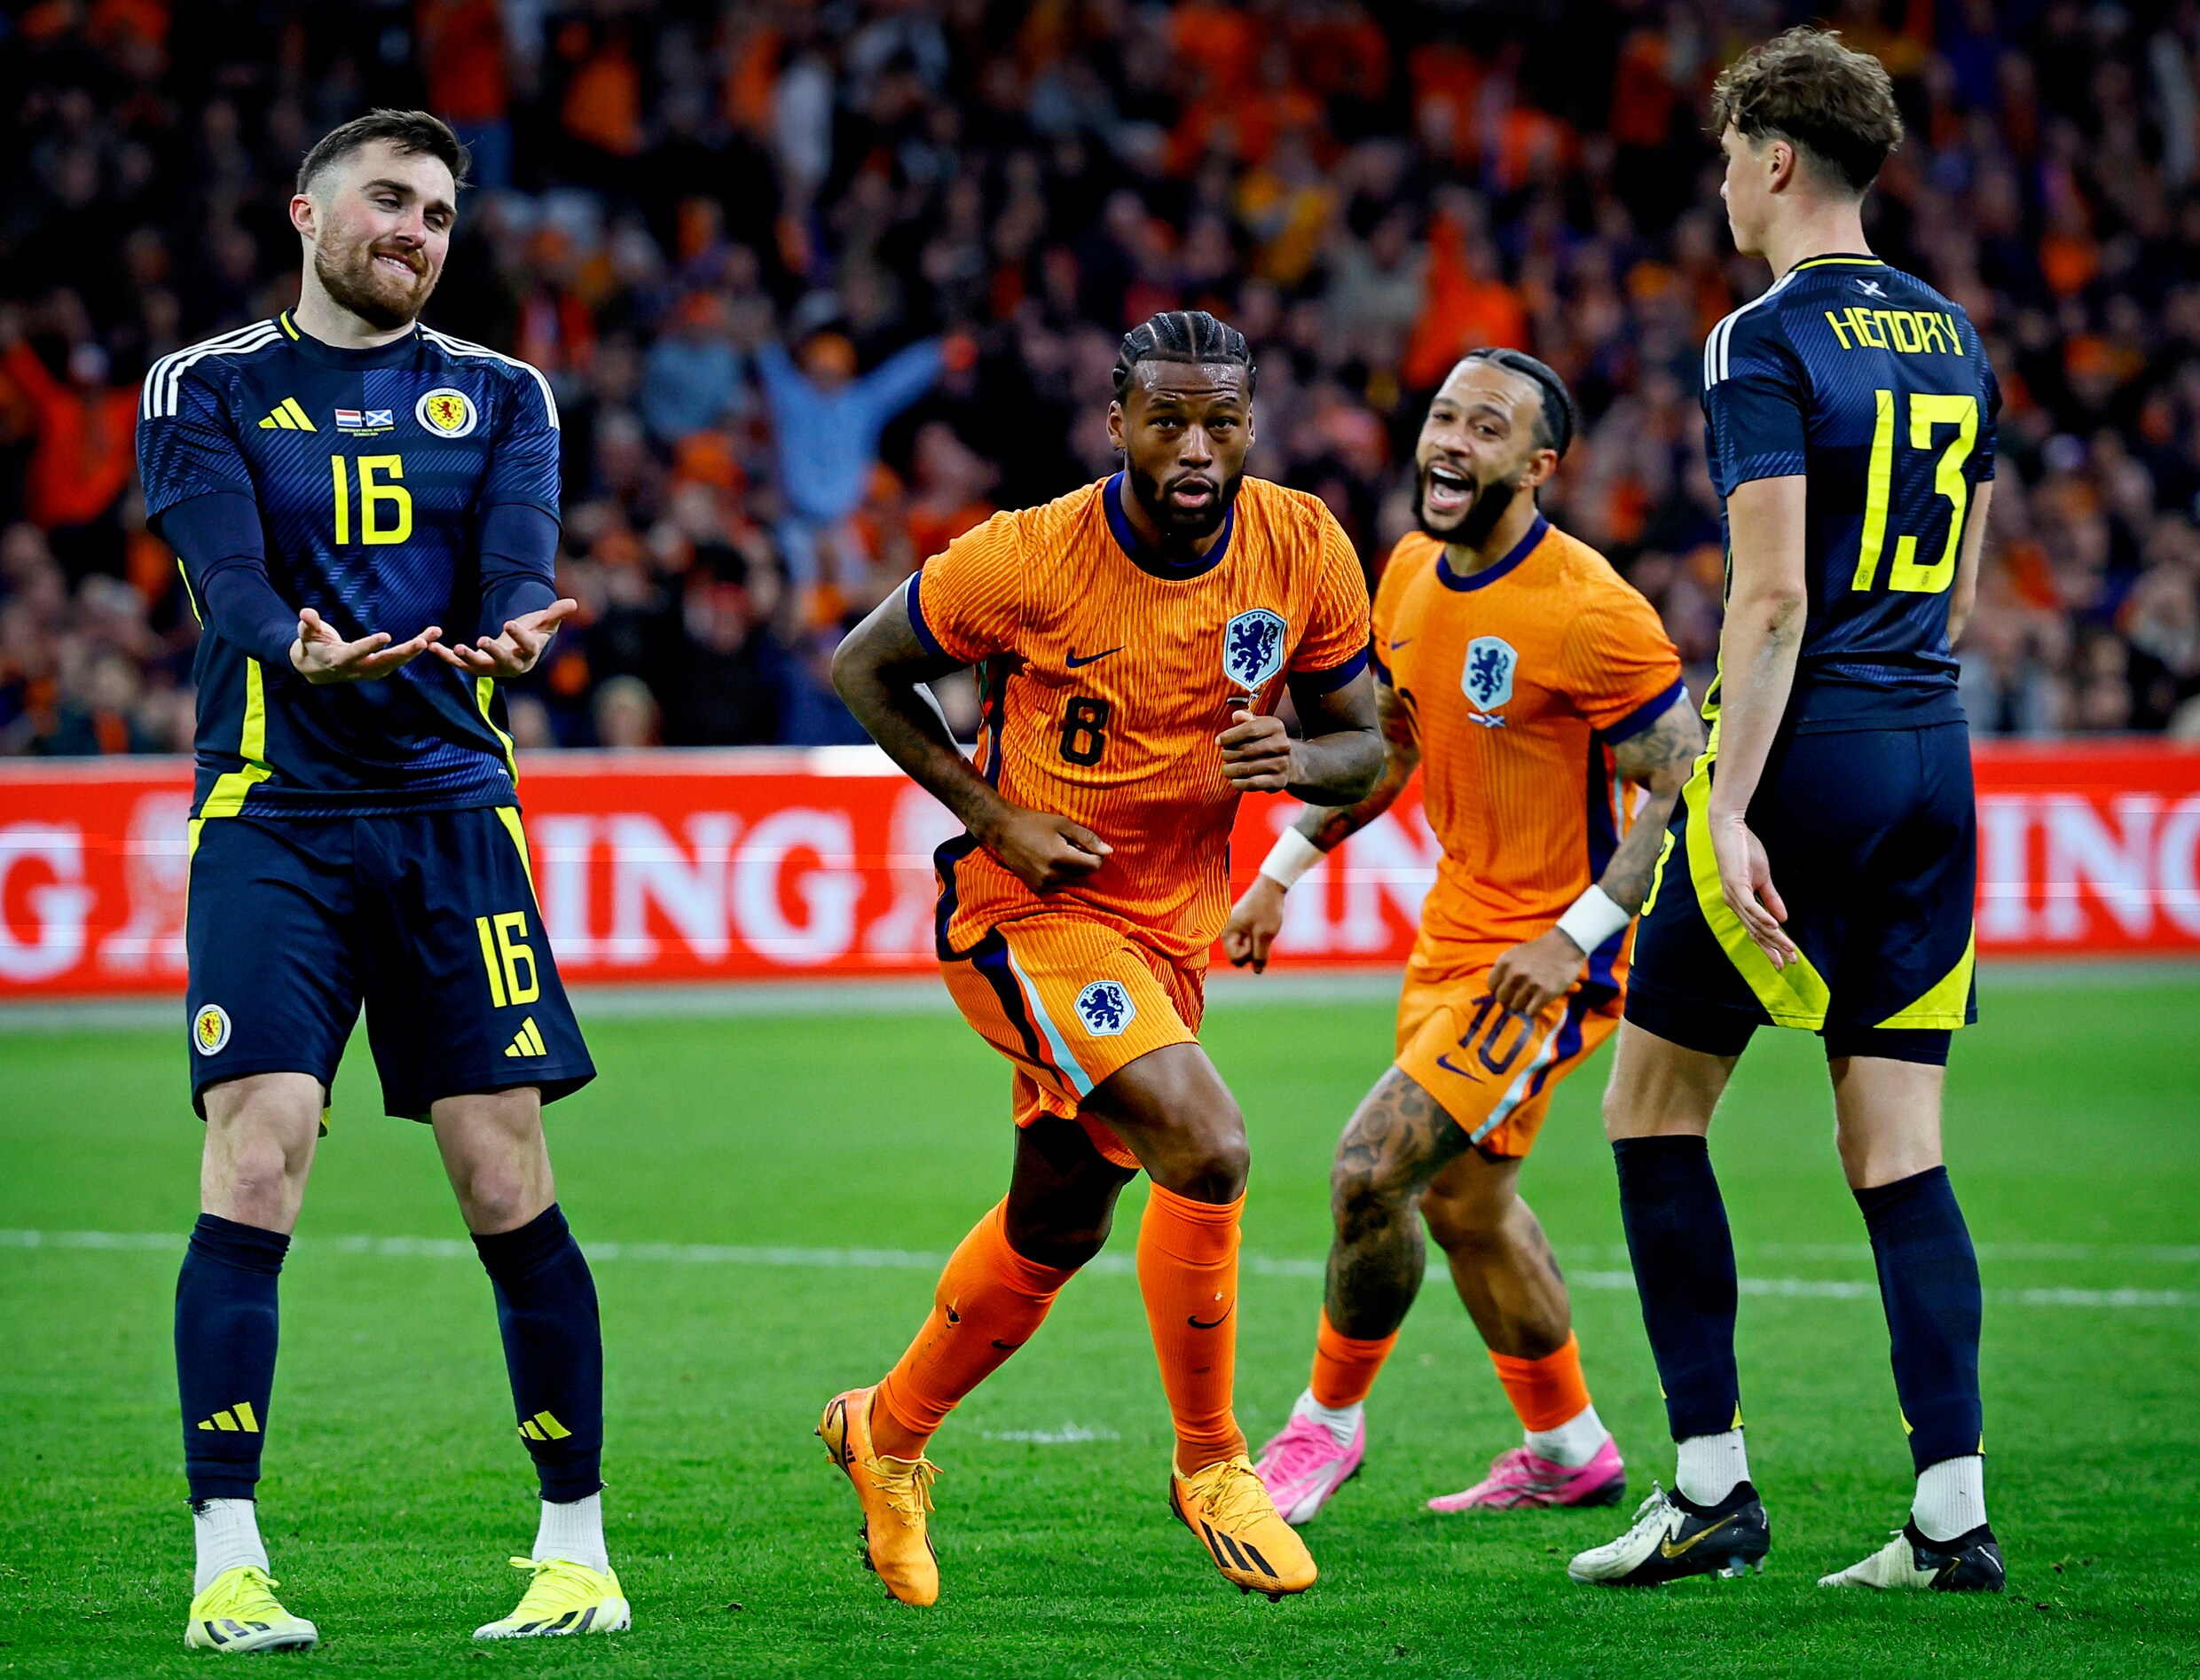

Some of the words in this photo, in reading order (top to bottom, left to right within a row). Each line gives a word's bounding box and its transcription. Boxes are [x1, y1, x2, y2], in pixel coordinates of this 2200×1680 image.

[1825, 307, 1963, 356] HENDRY
[331, 454, 412, 545] 16
[1851, 389, 1978, 593] 13
[1059, 695, 1109, 766] 8
[534, 805, 865, 967] ING
[1266, 802, 1445, 954] IN
[475, 911, 539, 1008] 16
[1458, 993, 1534, 1075] 10
